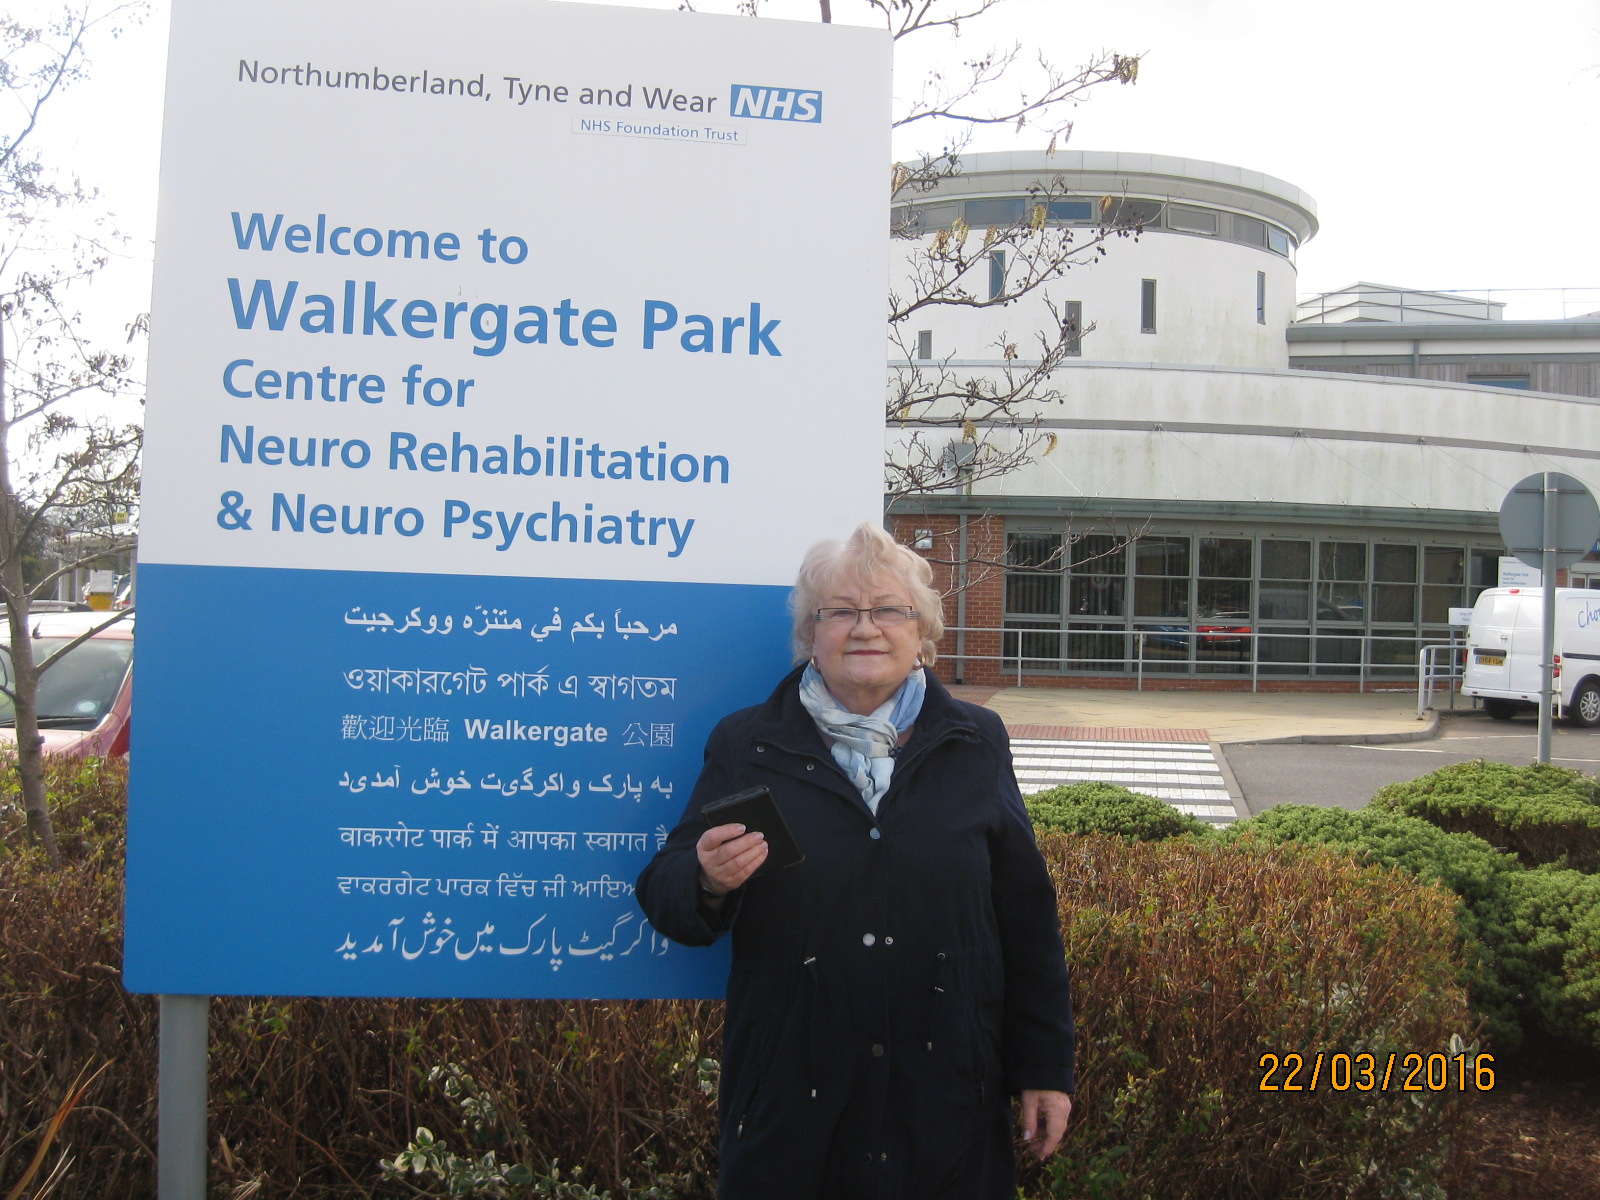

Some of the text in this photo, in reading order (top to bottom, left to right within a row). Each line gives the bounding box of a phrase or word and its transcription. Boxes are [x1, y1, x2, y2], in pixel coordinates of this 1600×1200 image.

[238, 59, 819, 122] Northumberland, Tyne and Wear NHS
[581, 119, 738, 142] NHS Foundation Trust
[230, 211, 529, 265] Welcome to
[226, 277, 783, 357] Walkergate Park
[222, 358, 475, 408] Centre for
[219, 424, 730, 484] Neuro Rehabilitation
[216, 489, 696, 559] & Neuro Psychiatry
[344, 606, 454, 635] ووكرجيت
[530, 606, 563, 643] في
[570, 612, 606, 643] بكم
[1577, 600, 1600, 628] cho
[496, 664, 550, 698] পার্ক
[558, 675, 578, 698] এ
[587, 673, 678, 700] স্বাগতম
[341, 714, 675, 748] 歡迎光臨 Walkergate 公園
[411, 767, 472, 796] خوش
[650, 775, 673, 800] به
[338, 820, 425, 849] वाकरगेट
[429, 822, 475, 849] पार्क
[480, 822, 500, 850] में
[507, 830, 577, 851] आपका
[583, 832, 648, 852] स्वागत
[435, 878, 492, 897] ਪਾਰਕ
[541, 873, 567, 898] ਜੀ
[401, 911, 456, 960] خوش
[454, 921, 495, 961] میں
